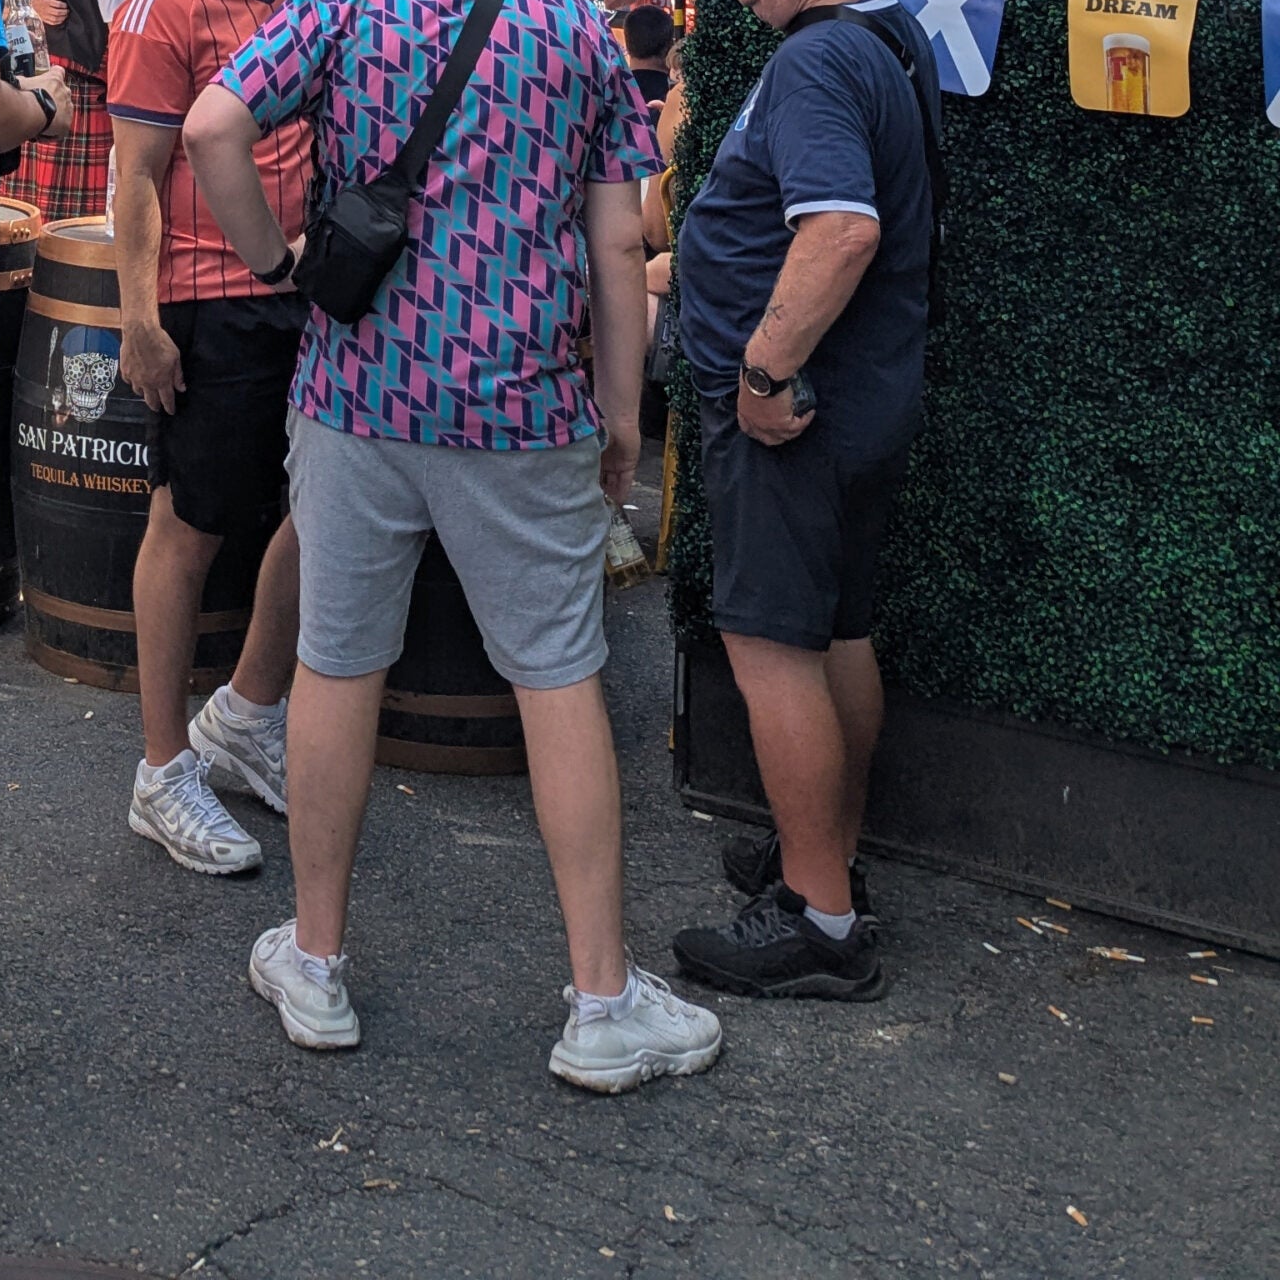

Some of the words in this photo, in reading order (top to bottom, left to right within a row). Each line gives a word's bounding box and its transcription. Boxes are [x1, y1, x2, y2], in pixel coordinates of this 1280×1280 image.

[18, 422, 48, 451] SAN
[30, 461, 80, 487] TEQUILA
[82, 473, 152, 494] WHISKEY
